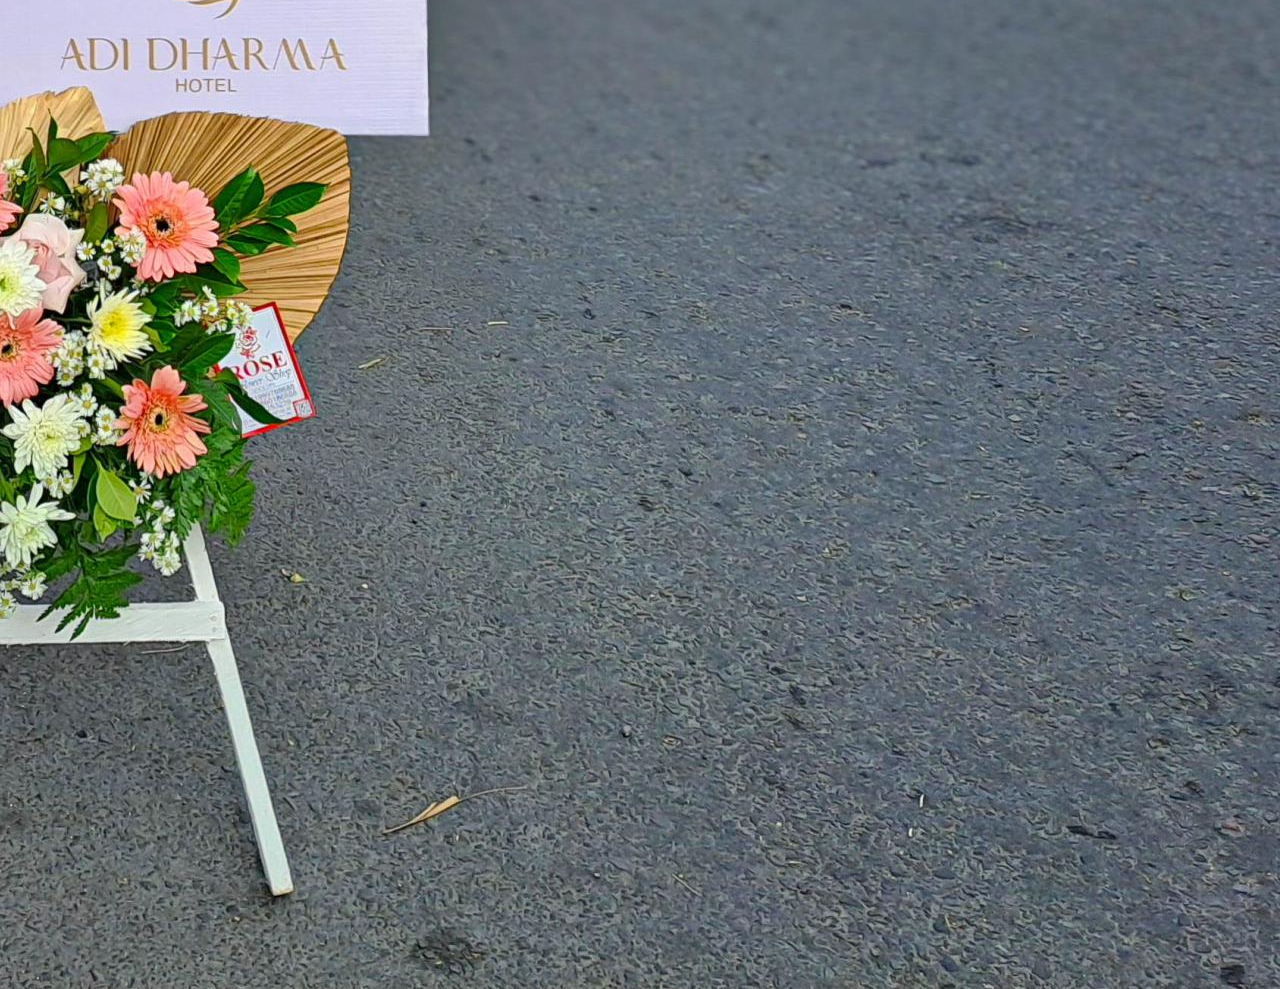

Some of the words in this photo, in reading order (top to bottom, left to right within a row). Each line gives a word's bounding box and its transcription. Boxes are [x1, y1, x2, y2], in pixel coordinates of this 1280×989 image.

[60, 38, 130, 71] ADI
[147, 38, 348, 71] DHARMA
[175, 78, 237, 93] HOTEL
